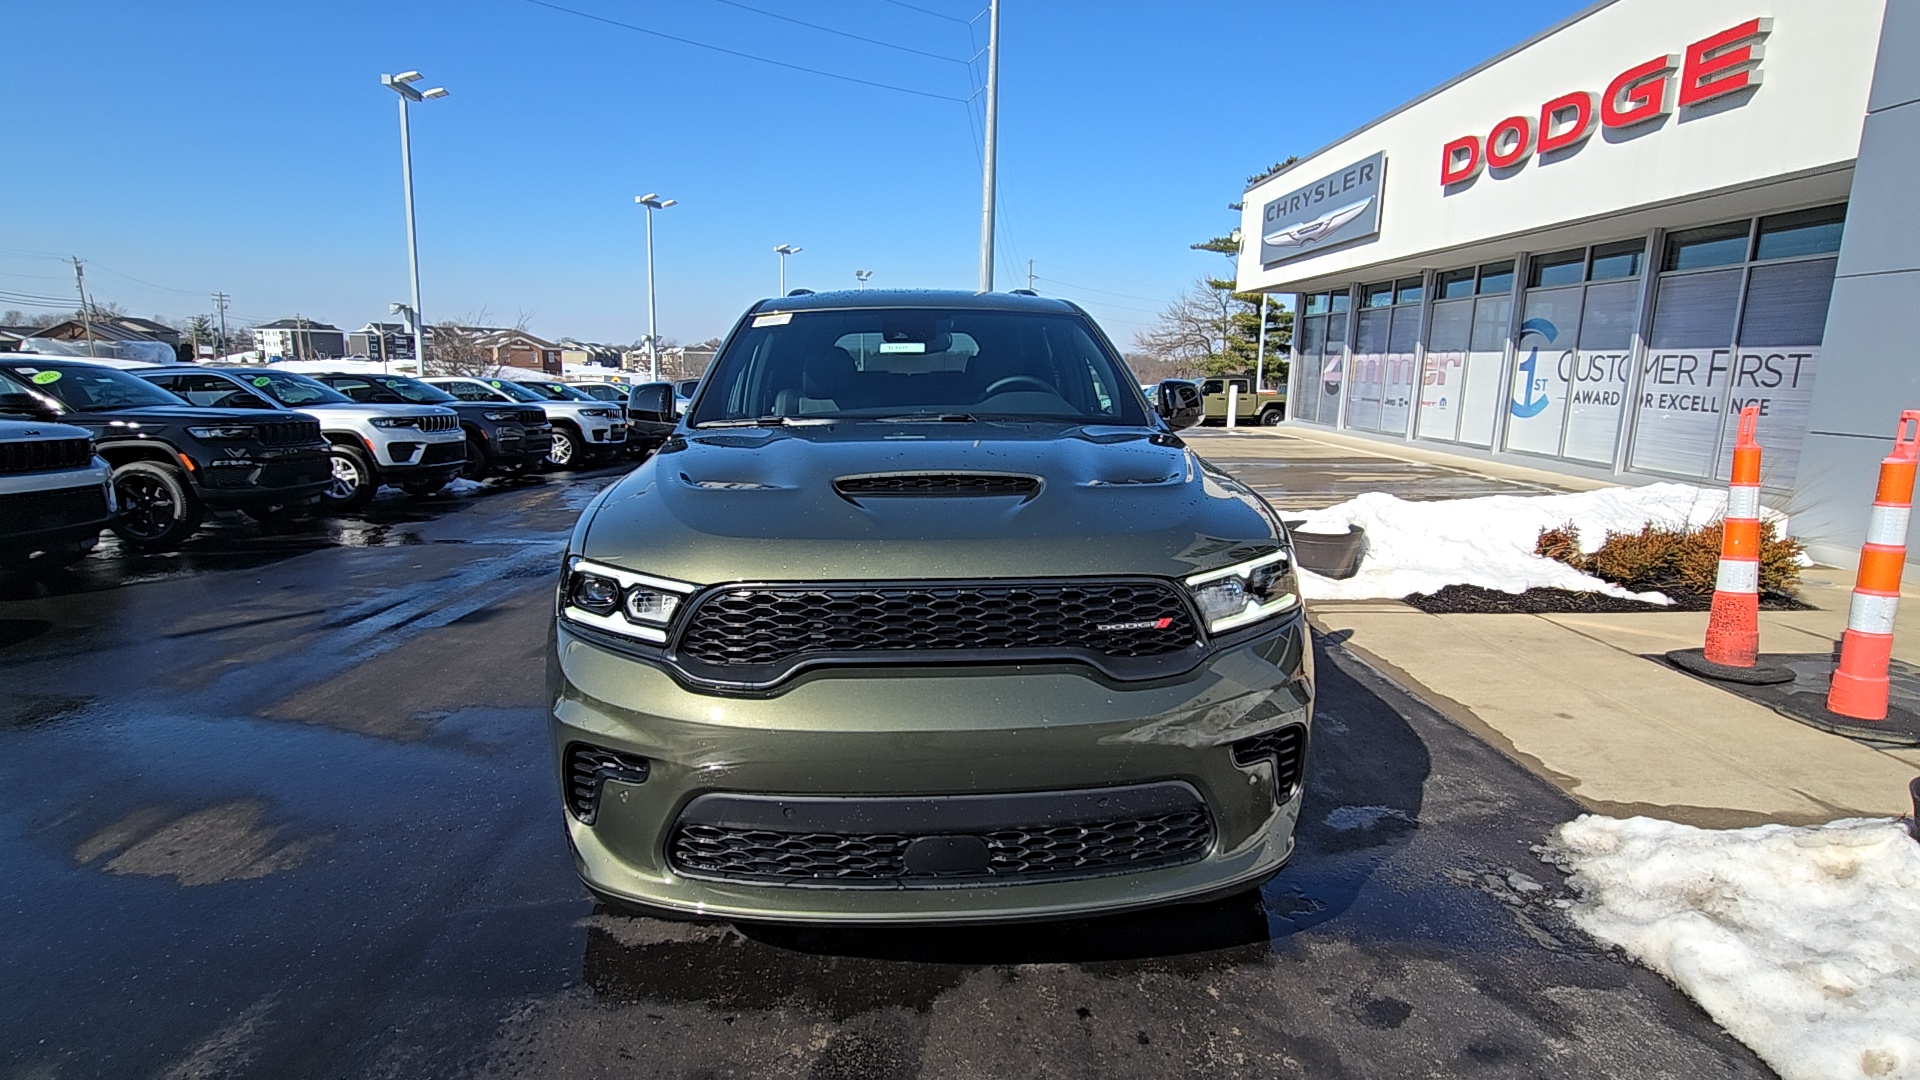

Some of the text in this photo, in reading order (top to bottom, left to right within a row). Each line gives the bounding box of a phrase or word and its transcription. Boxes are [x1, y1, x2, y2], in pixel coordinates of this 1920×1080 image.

[1441, 17, 1766, 186] DODGE
[1265, 162, 1374, 222] CHRYSLER
[1323, 350, 1461, 387] Zmmer
[1706, 349, 1812, 388] FIRST
[1572, 390, 1621, 406] AWARD
[1658, 393, 1771, 416] EXCELLNCE
[1096, 621, 1161, 631] DODGE
